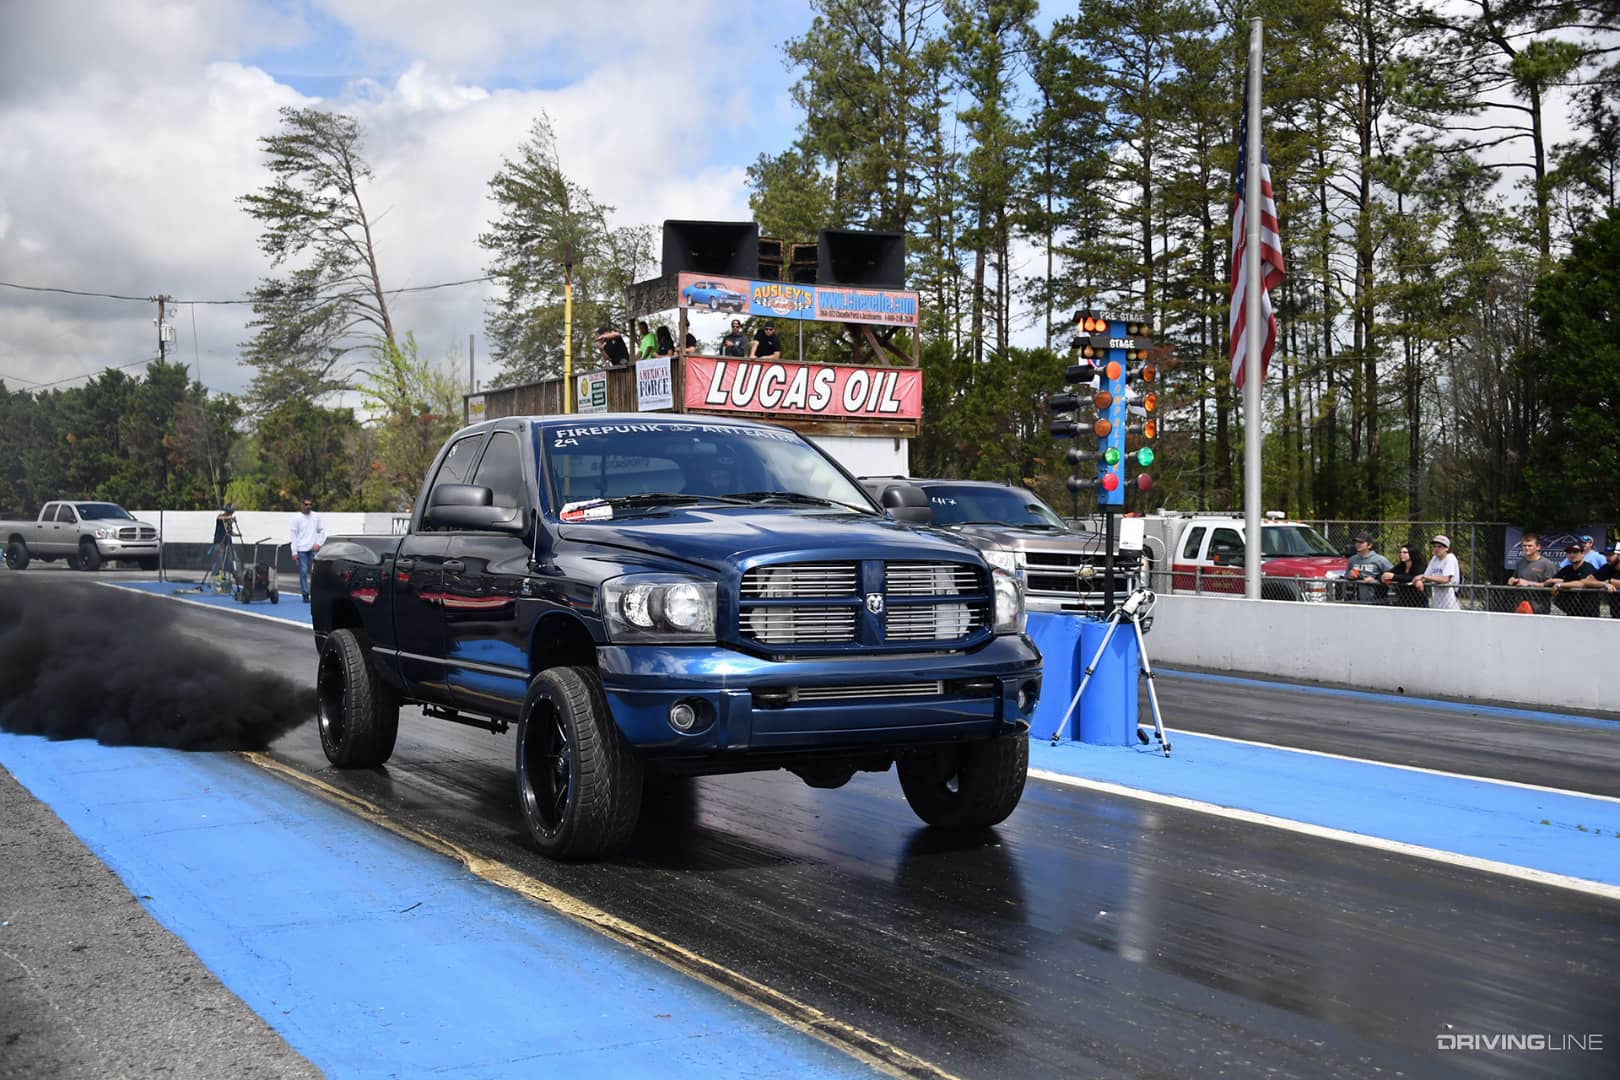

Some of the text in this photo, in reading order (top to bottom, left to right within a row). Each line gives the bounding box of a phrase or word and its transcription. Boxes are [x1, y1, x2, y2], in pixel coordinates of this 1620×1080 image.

[753, 284, 812, 306] AUSLEY'S
[1109, 338, 1136, 349] STAGE
[640, 378, 669, 397] FORCE
[705, 361, 900, 413] LUCAS OIL
[556, 424, 663, 438] FIREPUNK
[554, 438, 579, 448] 29
